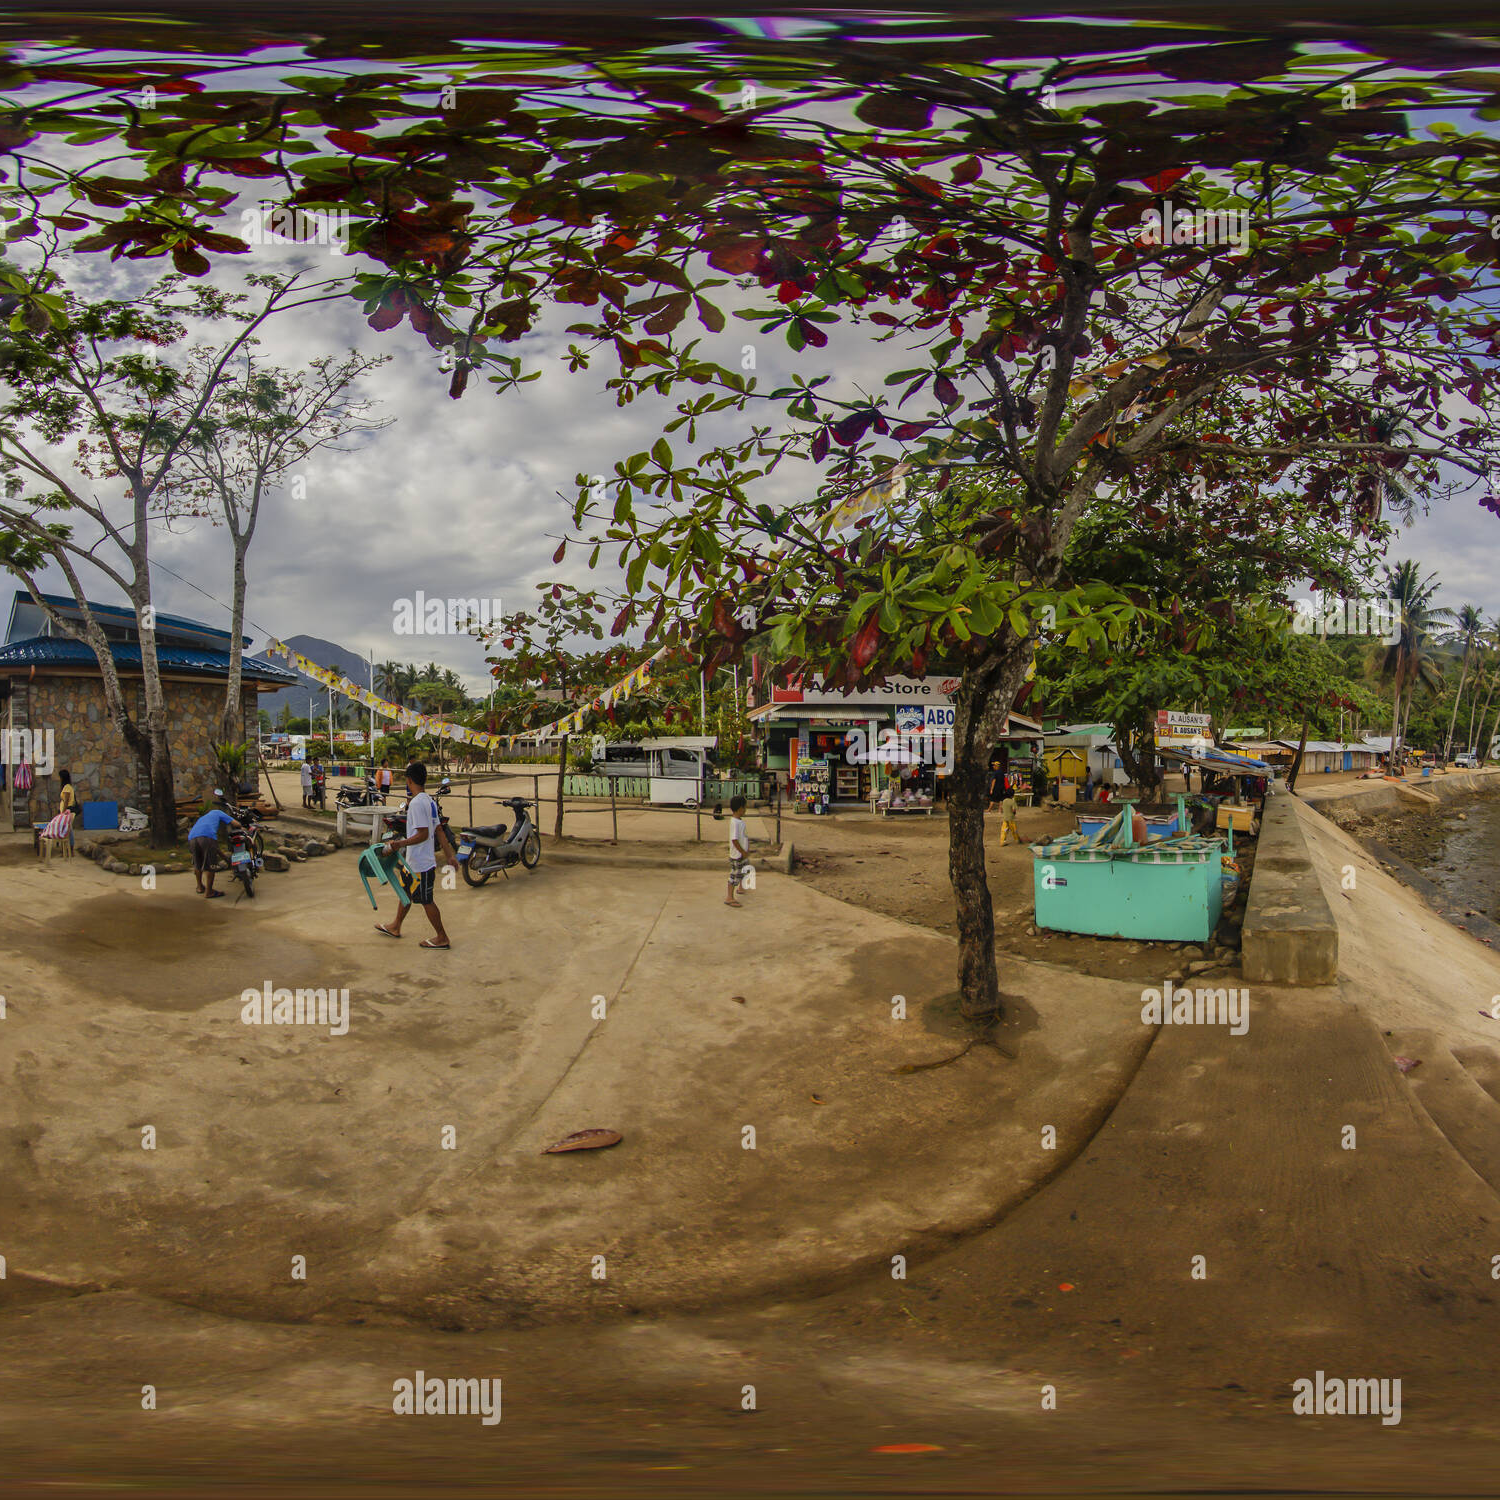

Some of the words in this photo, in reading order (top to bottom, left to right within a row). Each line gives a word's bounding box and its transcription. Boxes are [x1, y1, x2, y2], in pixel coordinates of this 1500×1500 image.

[882, 682, 931, 695] Store
[927, 709, 955, 725] ABO
[1178, 716, 1204, 725] AUSAN'S
